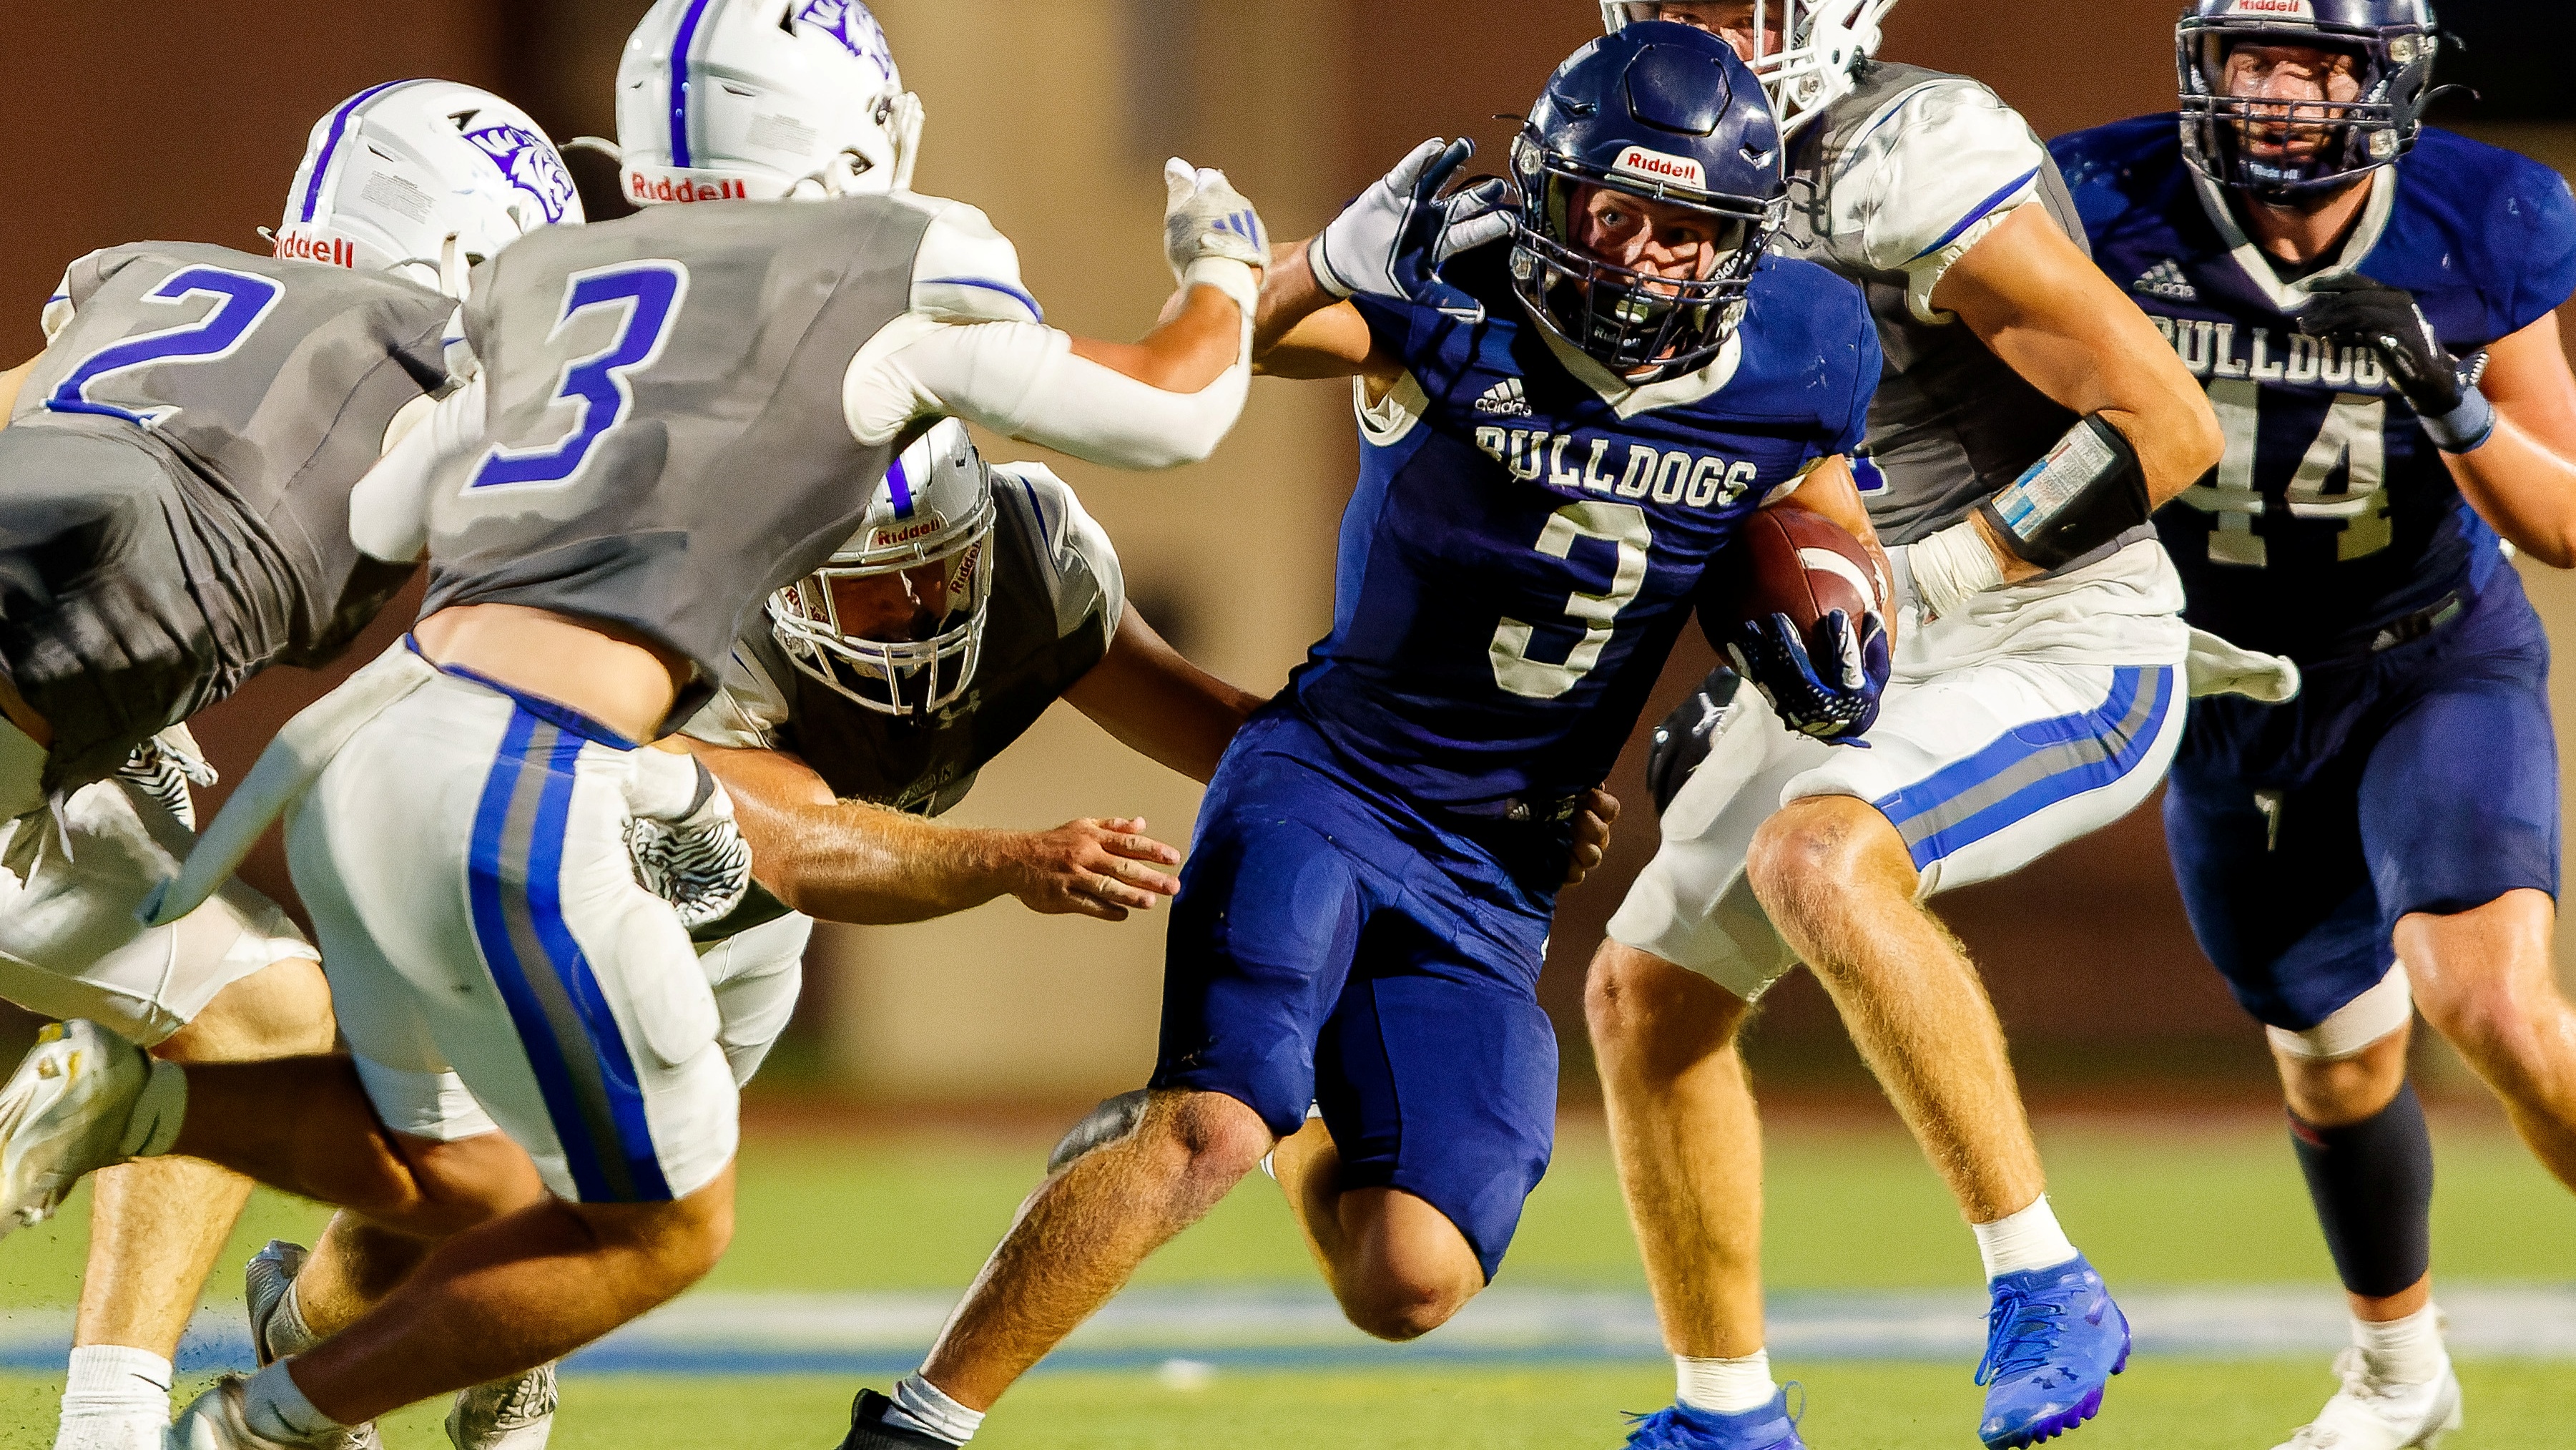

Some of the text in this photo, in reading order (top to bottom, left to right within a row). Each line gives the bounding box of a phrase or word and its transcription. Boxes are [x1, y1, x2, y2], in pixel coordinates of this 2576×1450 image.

[631, 171, 745, 203] Riddell
[1628, 152, 1695, 180] Riddell
[39, 263, 286, 429] 2
[458, 258, 690, 498] 3
[1475, 396, 1532, 417] adidas
[1475, 426, 1757, 508] BULLDOGS
[877, 519, 940, 546] Riddell
[1488, 500, 1652, 700] 3
